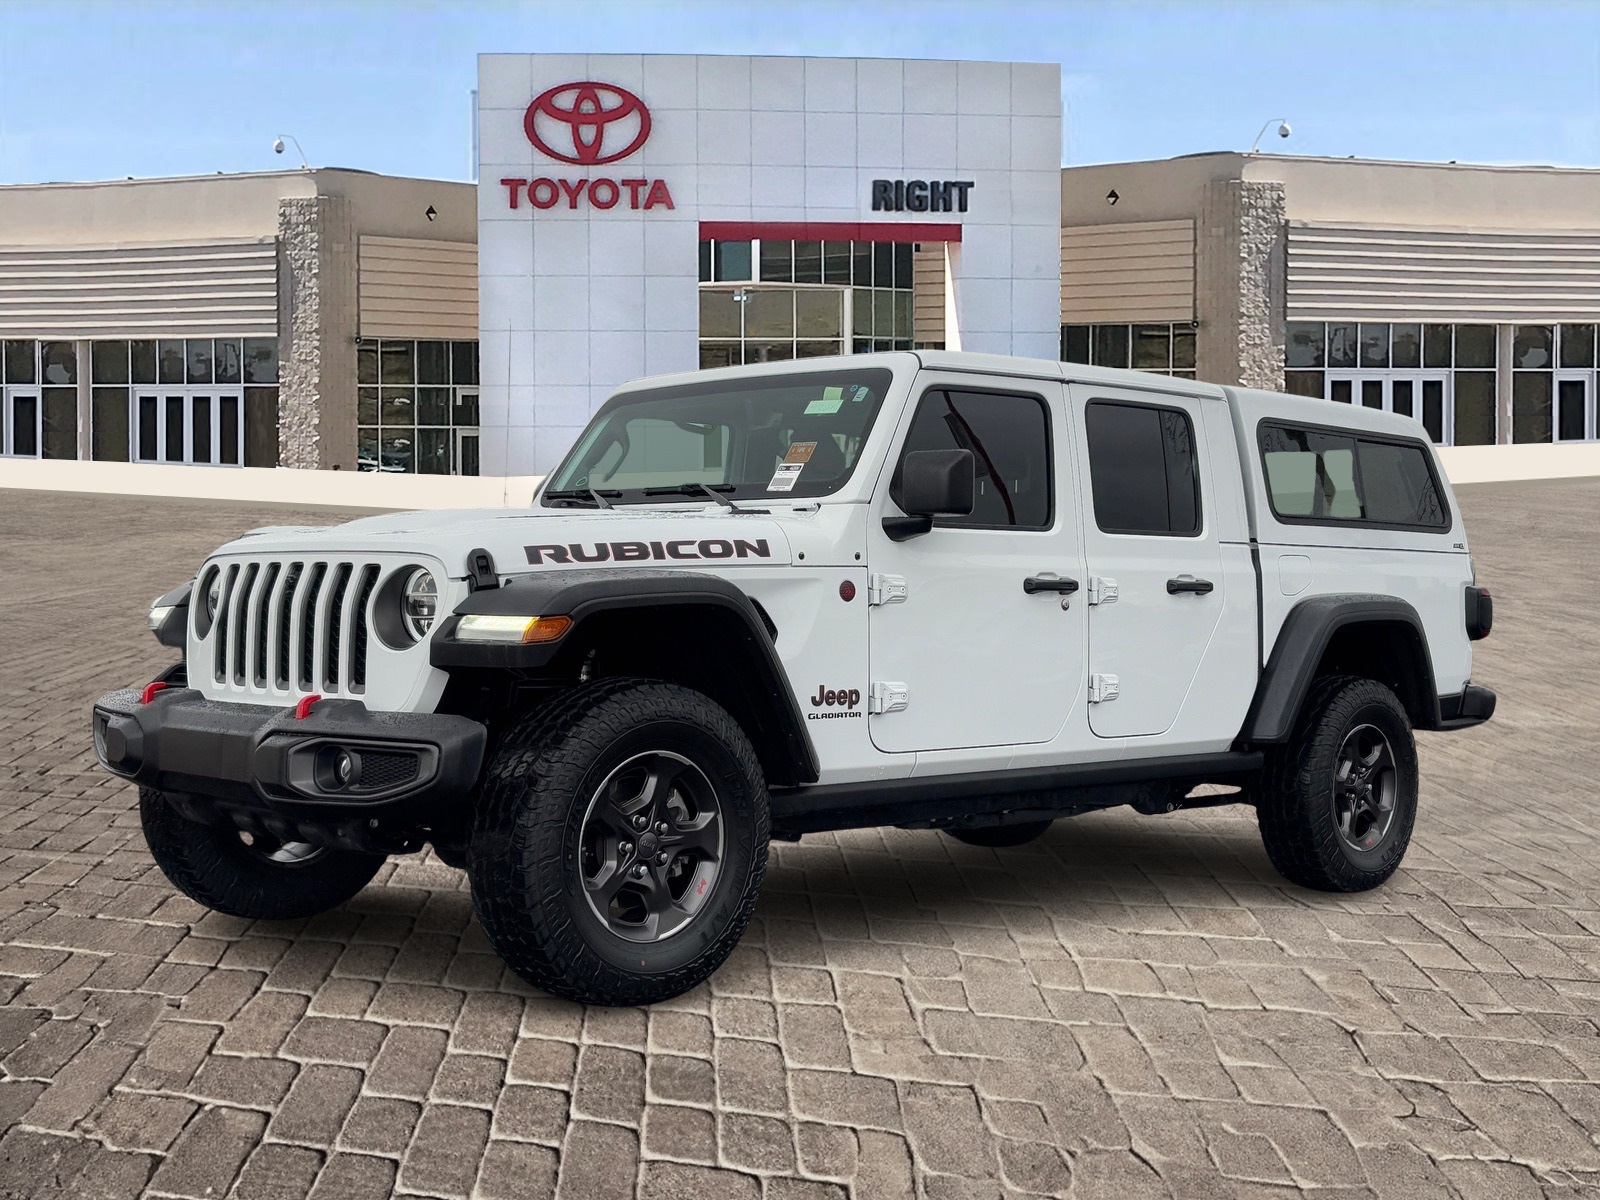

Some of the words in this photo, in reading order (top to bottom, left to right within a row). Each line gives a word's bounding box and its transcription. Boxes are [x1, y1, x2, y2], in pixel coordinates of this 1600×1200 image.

[501, 178, 674, 210] TOYOTA
[872, 180, 974, 211] RIGHT
[524, 539, 771, 564] RUBICON
[811, 685, 860, 709] Jeep
[808, 712, 861, 720] GLADIATOR
